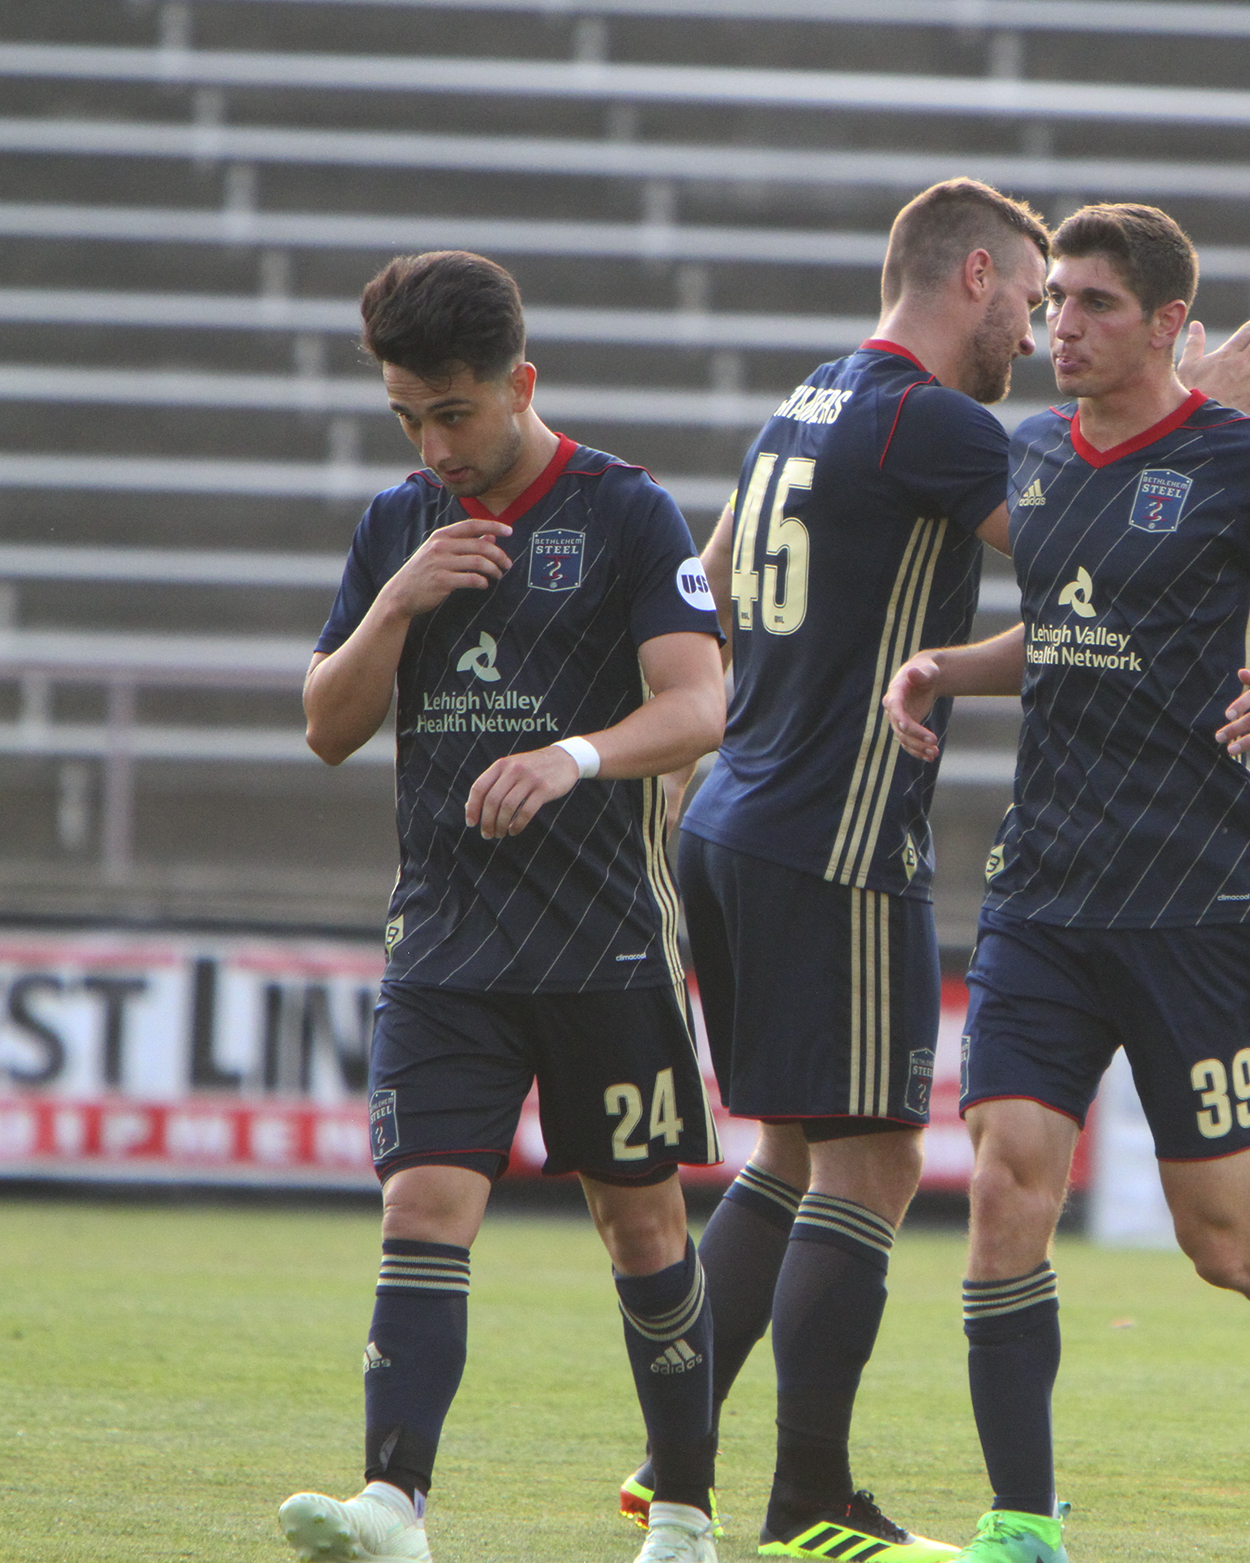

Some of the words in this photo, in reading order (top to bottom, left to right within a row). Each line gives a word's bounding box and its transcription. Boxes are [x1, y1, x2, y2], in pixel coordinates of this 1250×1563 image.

[1142, 484, 1182, 498] STEEL
[1143, 476, 1188, 490] BETHLEHEM
[1019, 497, 1046, 506] adidas
[535, 545, 579, 554] STEEL
[731, 452, 816, 635] 45
[1031, 623, 1072, 647] Lehigh
[1075, 625, 1131, 652] Valley
[1026, 644, 1059, 665] Health
[1061, 646, 1142, 671] Network
[423, 691, 480, 714] Lehigh
[483, 691, 543, 714] Valley
[416, 714, 467, 733] Health
[471, 713, 559, 732] Network
[371, 1105, 392, 1125] STEEL
[604, 1066, 684, 1162] 24
[650, 1353, 703, 1375] adidas
